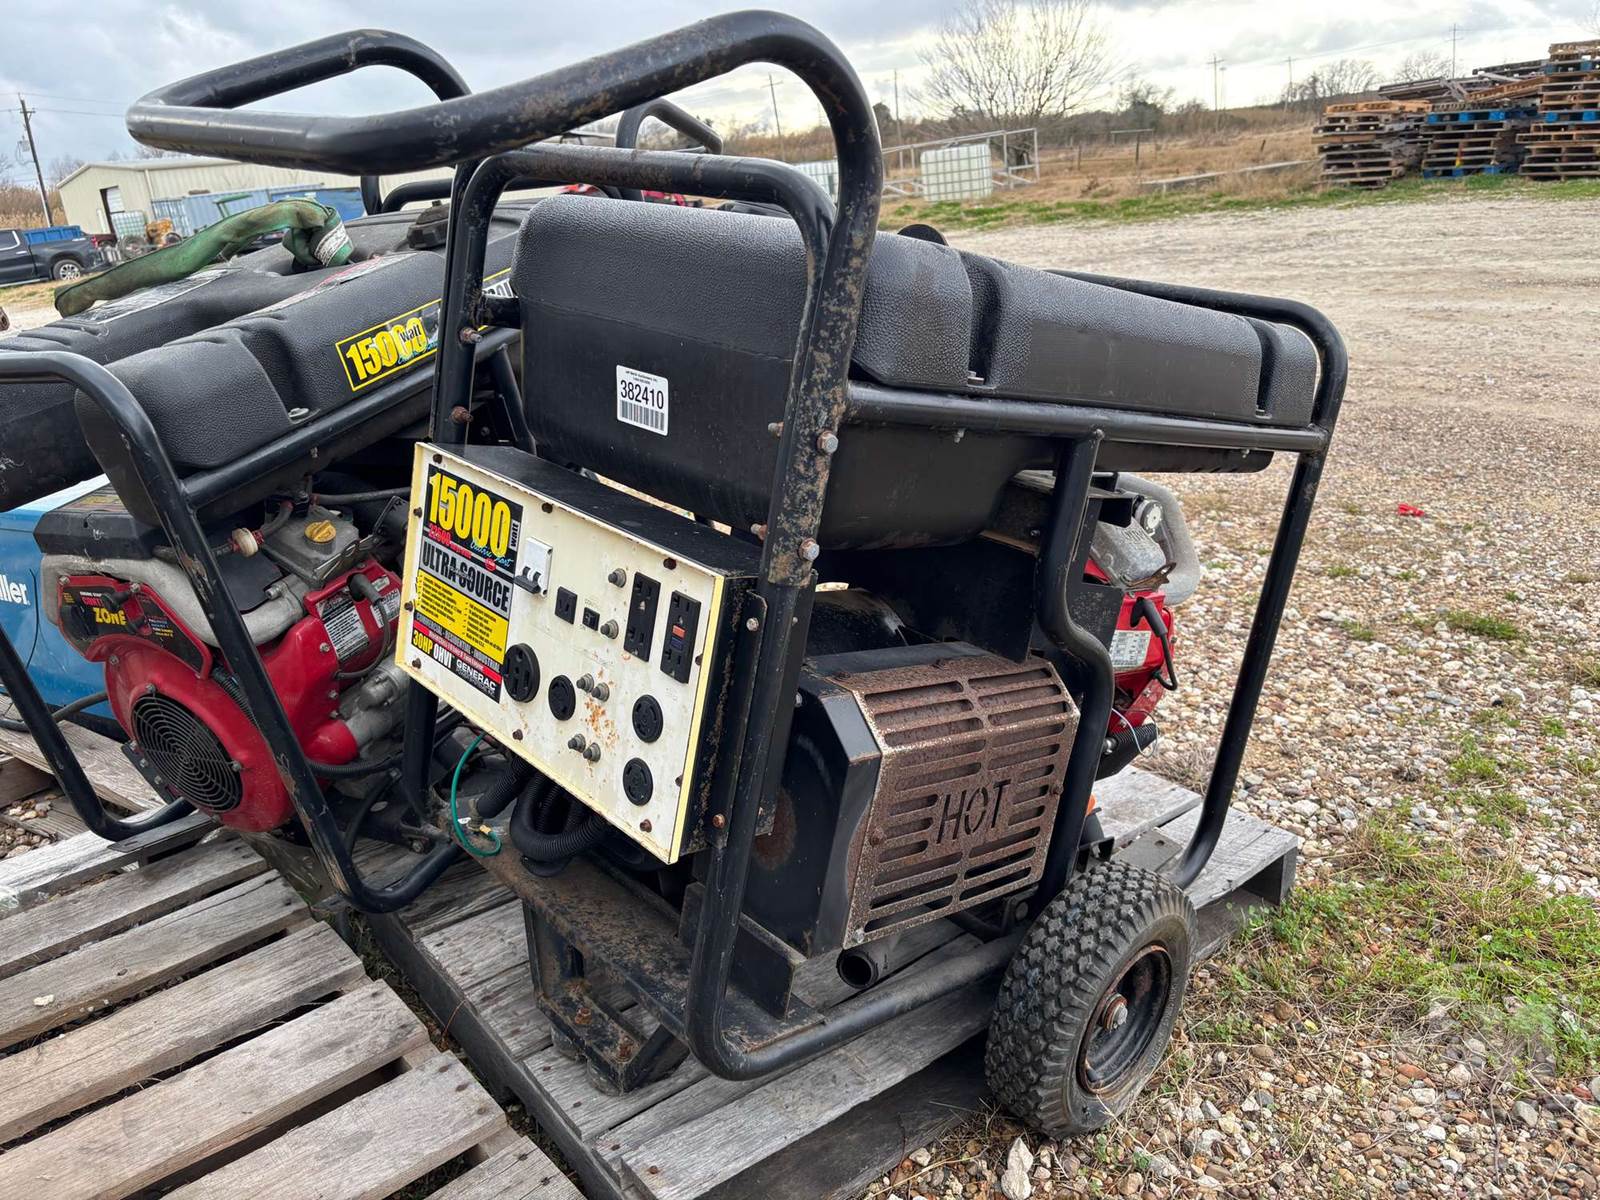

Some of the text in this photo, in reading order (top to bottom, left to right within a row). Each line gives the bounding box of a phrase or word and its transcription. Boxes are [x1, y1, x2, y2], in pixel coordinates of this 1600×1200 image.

[346, 317, 427, 381] 15000
[620, 379, 664, 409] 382410
[429, 472, 511, 558] 15000
[422, 540, 457, 583] ULTRA
[459, 561, 510, 612] SOURCE
[456, 658, 496, 690] GENERAC
[936, 779, 1012, 844] HOT
